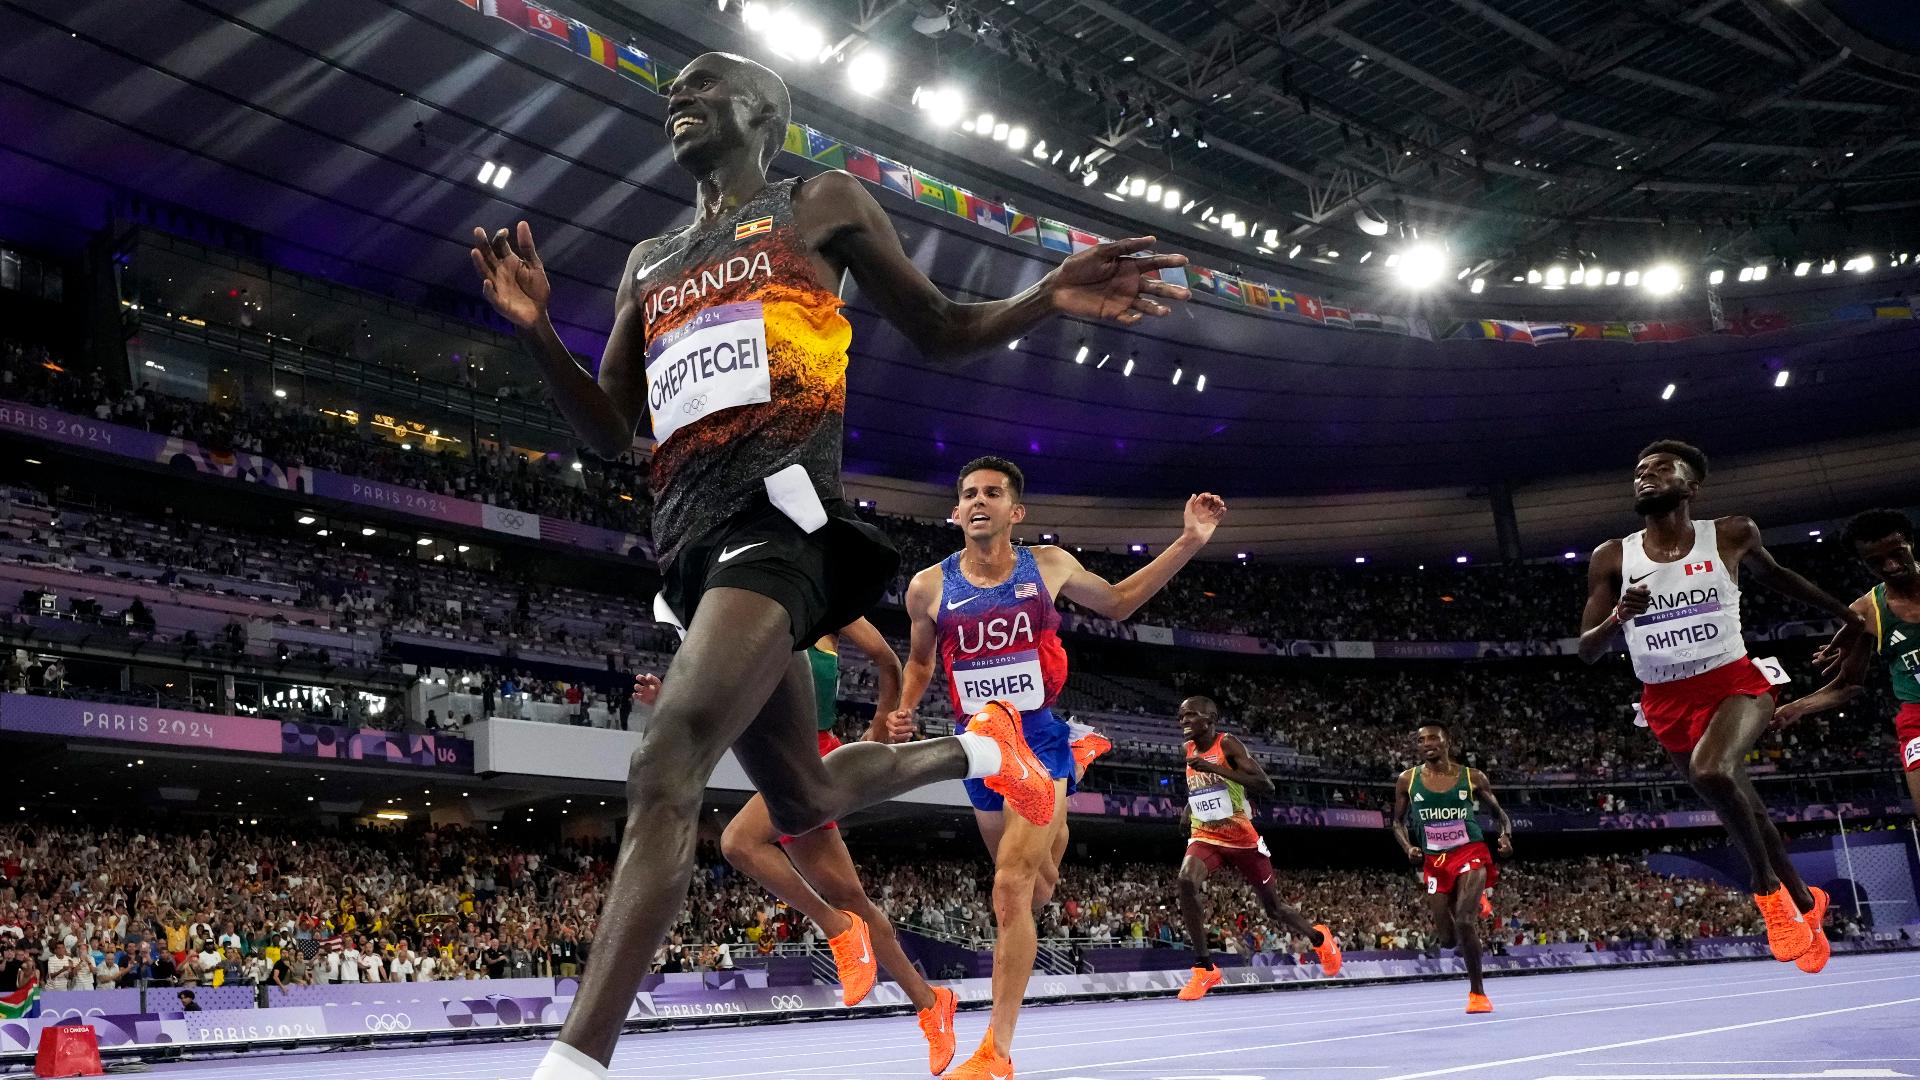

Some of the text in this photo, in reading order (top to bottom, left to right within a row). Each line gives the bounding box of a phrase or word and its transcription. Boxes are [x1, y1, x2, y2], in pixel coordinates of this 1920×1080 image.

[644, 251, 772, 324] UGANDA
[650, 337, 760, 412] CHEPTEGEI
[57, 420, 112, 444] 2024
[353, 483, 448, 514] PARIS 2024
[1649, 587, 1719, 610] ANADA
[1651, 608, 1698, 622] PARIS 2024
[957, 612, 1034, 653] USA
[1645, 622, 1719, 651] AHMED
[971, 655, 1016, 668] PARIS 2024
[964, 673, 1034, 698] FISHER
[83, 711, 213, 738] PARIS 2024
[438, 748, 457, 763] U6
[1195, 797, 1221, 812] KIBET
[1419, 808, 1468, 820] ETHIOPIA
[663, 1002, 740, 1017] PARIS 2024
[200, 1023, 316, 1041] PARIS 2024
